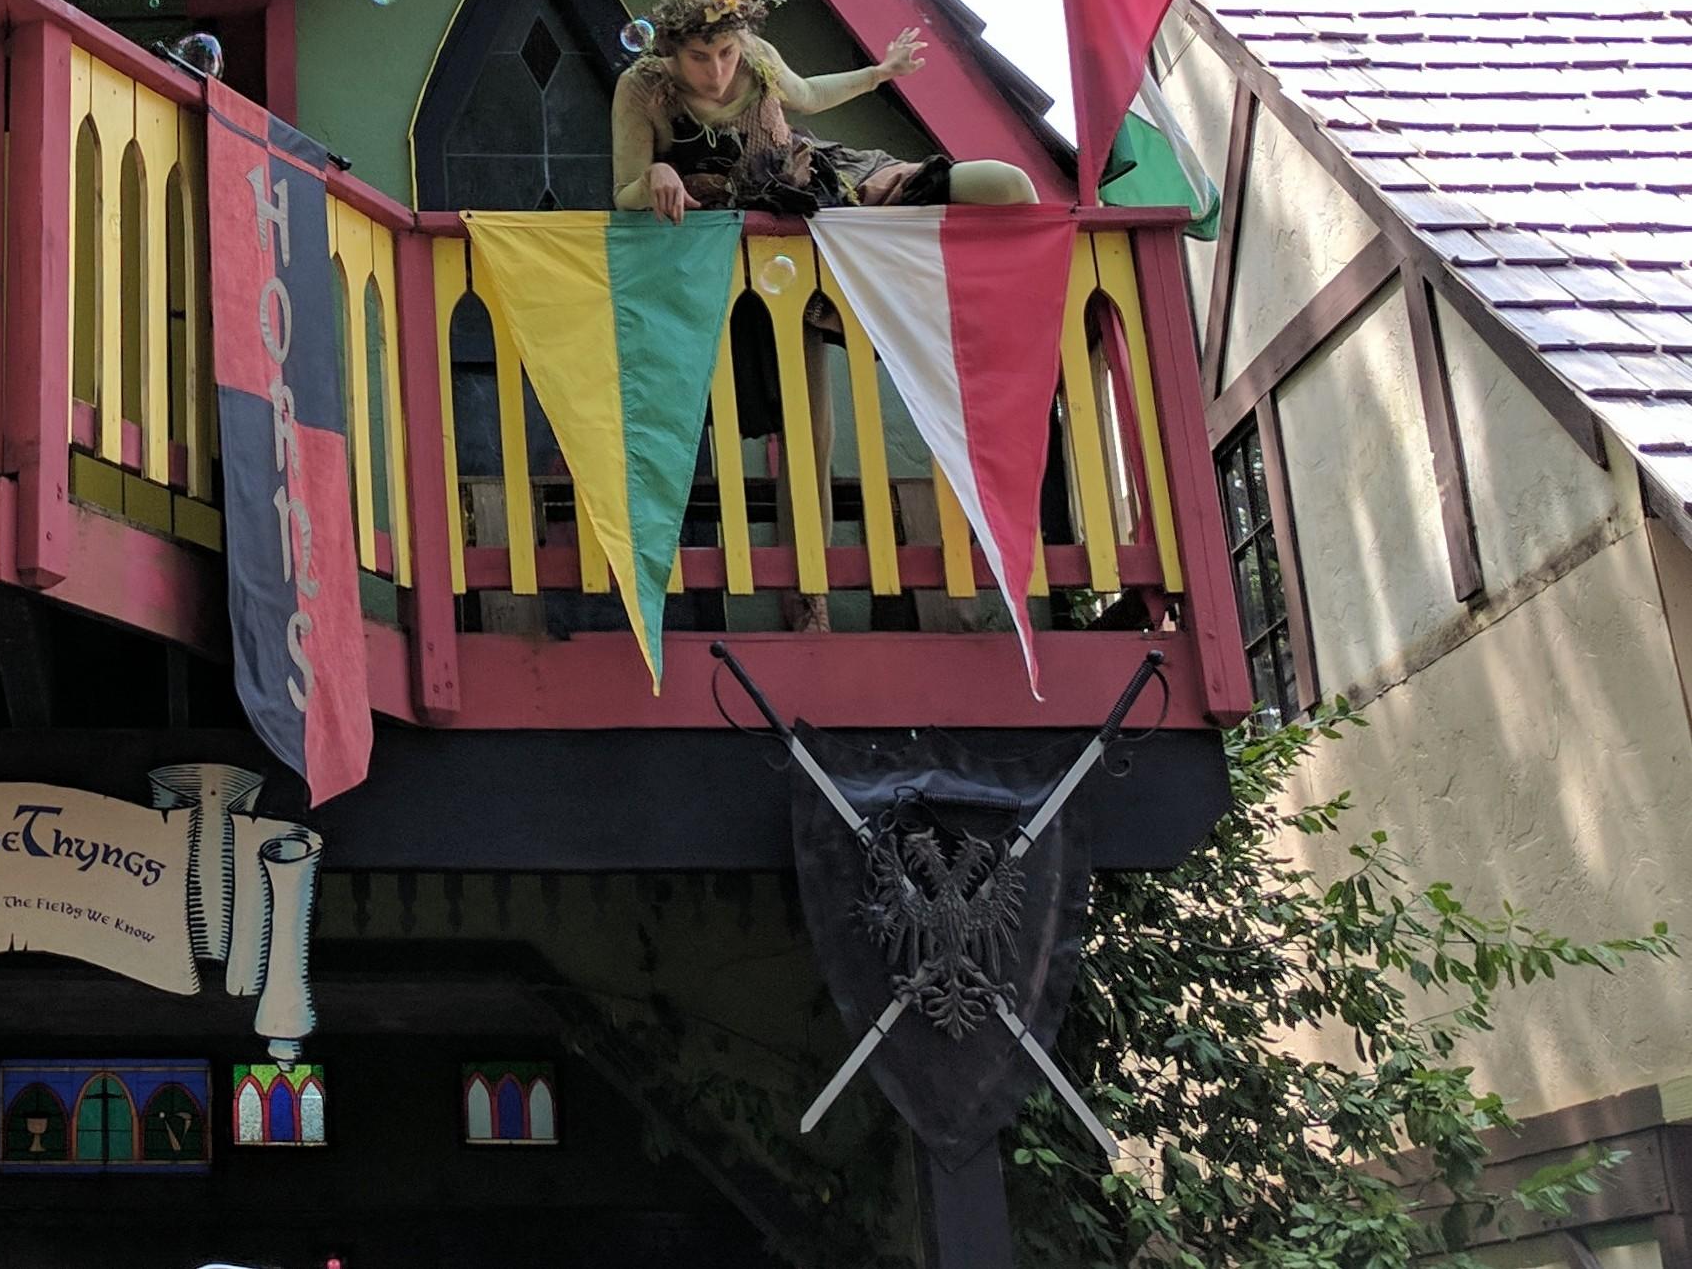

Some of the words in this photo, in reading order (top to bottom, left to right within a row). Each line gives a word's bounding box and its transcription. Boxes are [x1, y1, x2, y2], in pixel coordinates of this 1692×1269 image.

[3, 895, 32, 909] The
[36, 897, 84, 920] Fields
[87, 908, 111, 925] We
[114, 917, 156, 943] Know
